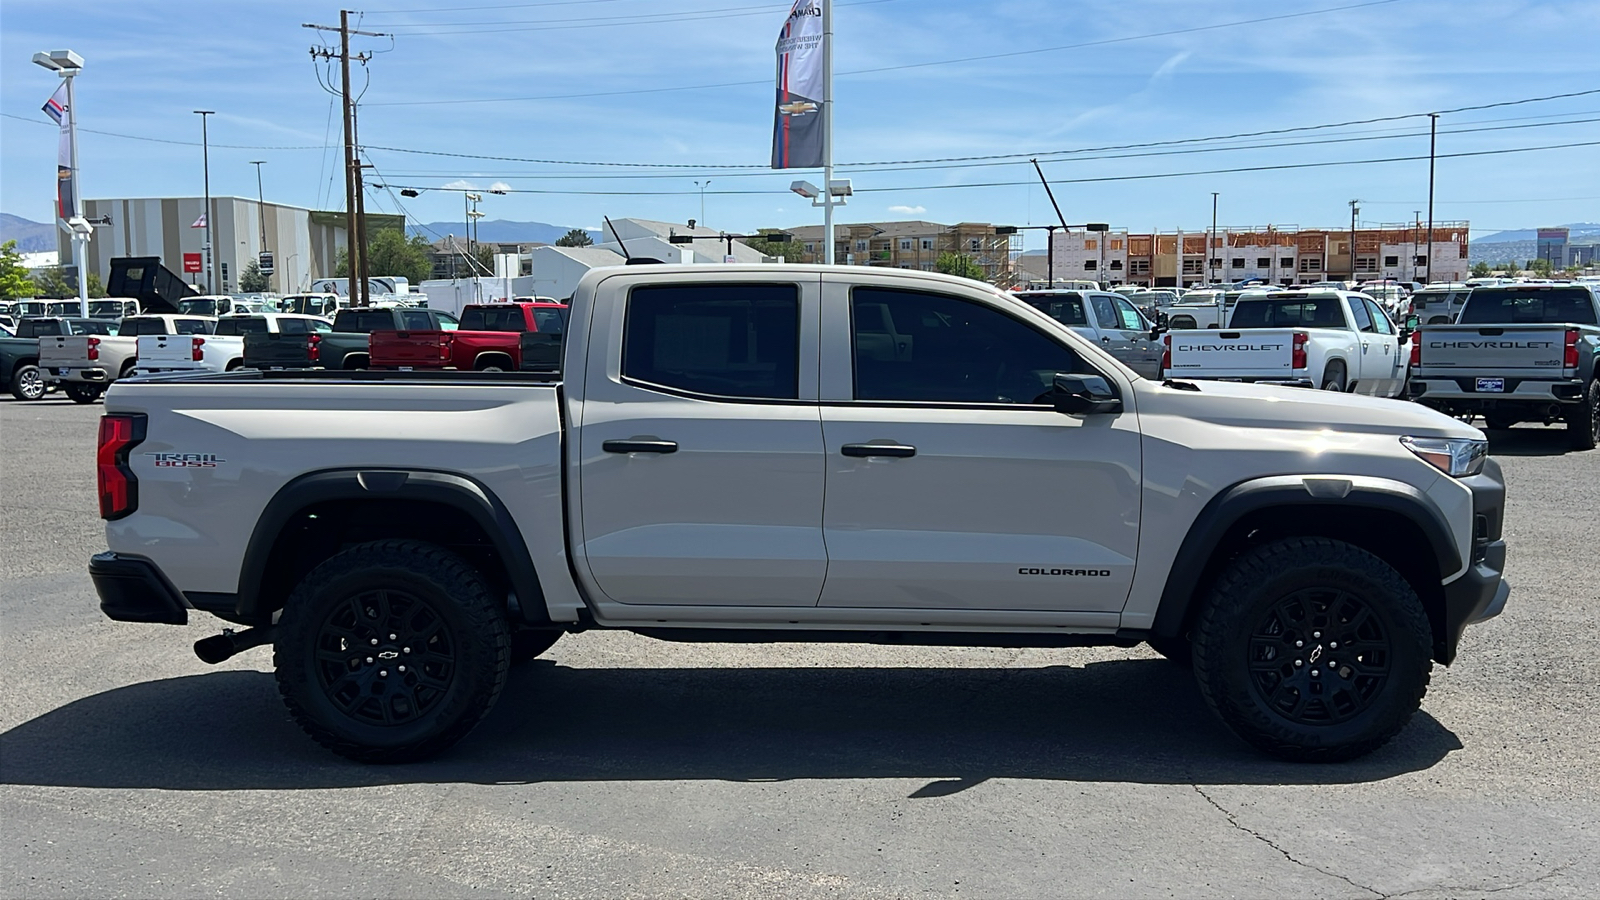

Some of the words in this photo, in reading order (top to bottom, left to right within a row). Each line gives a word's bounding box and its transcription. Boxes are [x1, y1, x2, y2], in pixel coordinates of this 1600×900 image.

[1178, 344, 1284, 352] CHEVROLET
[1430, 341, 1554, 349] CHEVROLET
[144, 453, 226, 462] TRAIL
[1018, 568, 1111, 577] COLORADO
